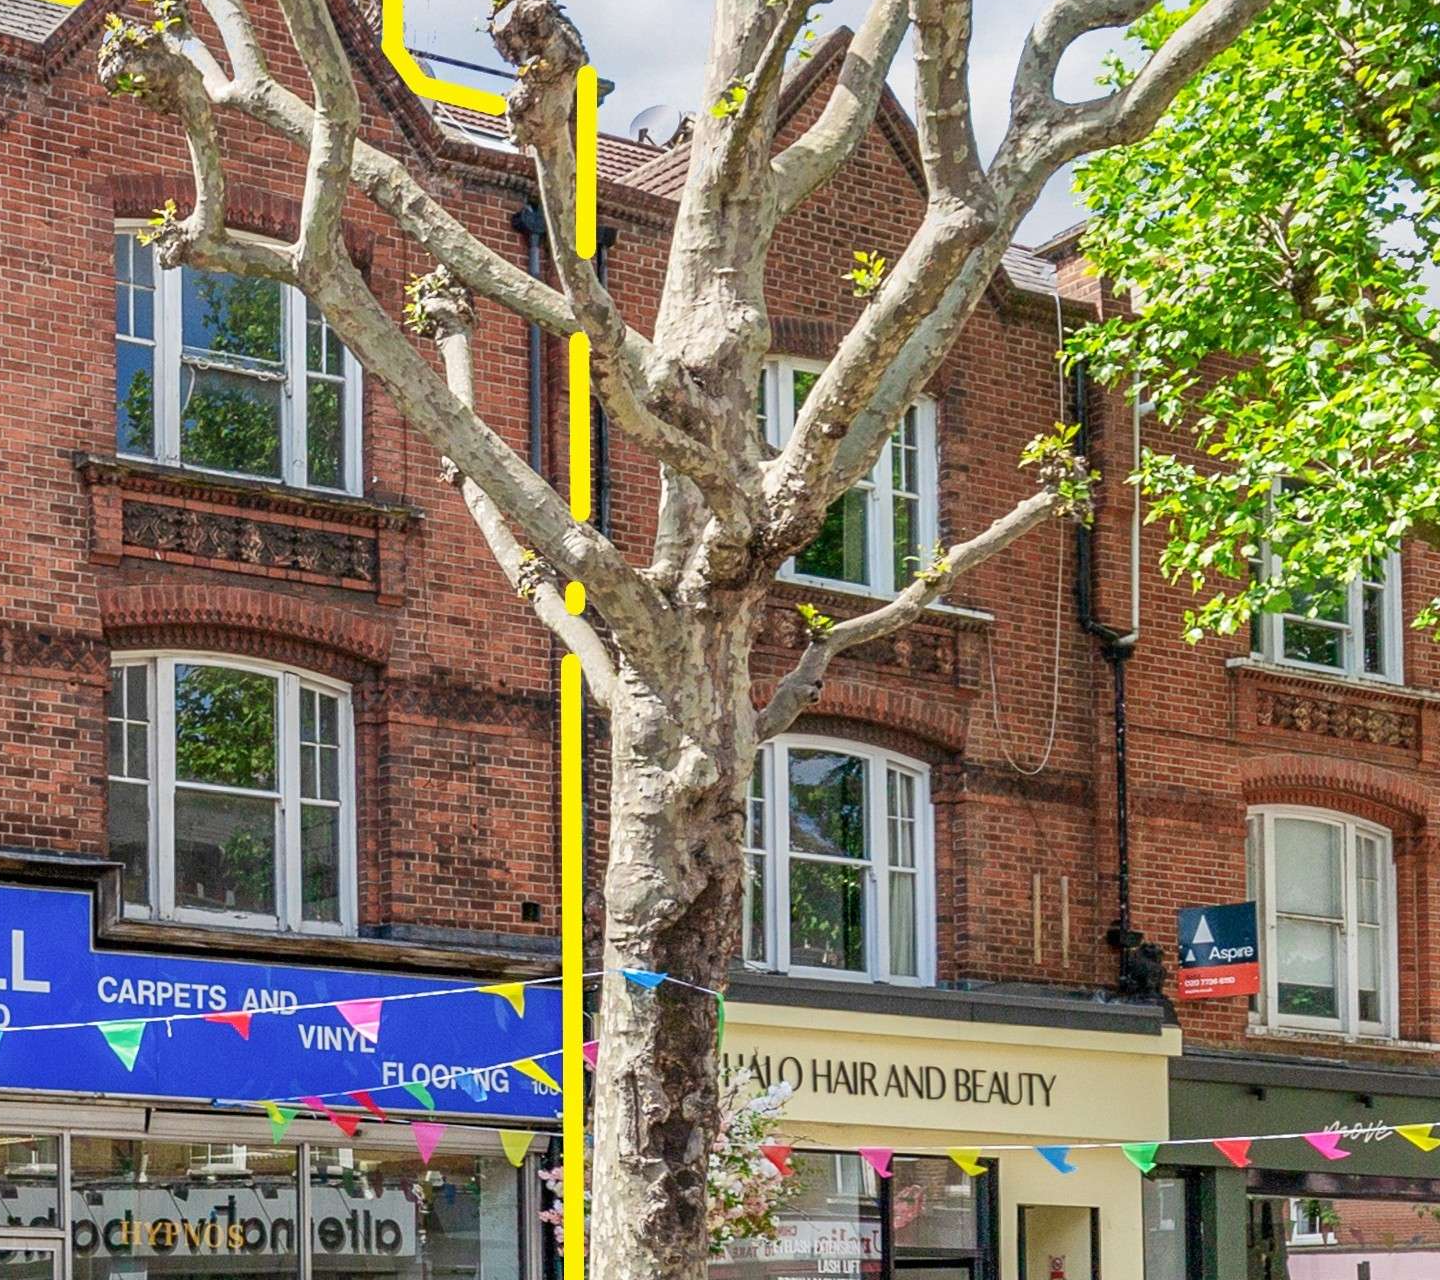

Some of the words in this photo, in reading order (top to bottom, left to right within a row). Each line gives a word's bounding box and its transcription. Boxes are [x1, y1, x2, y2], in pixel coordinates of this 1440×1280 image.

[1208, 945, 1254, 963] Aspire
[97, 975, 227, 1012] CARPETS
[243, 988, 299, 1016] AND
[382, 1061, 510, 1093] FLOORNG
[812, 1058, 880, 1097] HAIR
[884, 1063, 947, 1100] AND
[955, 1068, 1057, 1107] BEAUTY
[120, 1220, 244, 1250] HYPNOS
